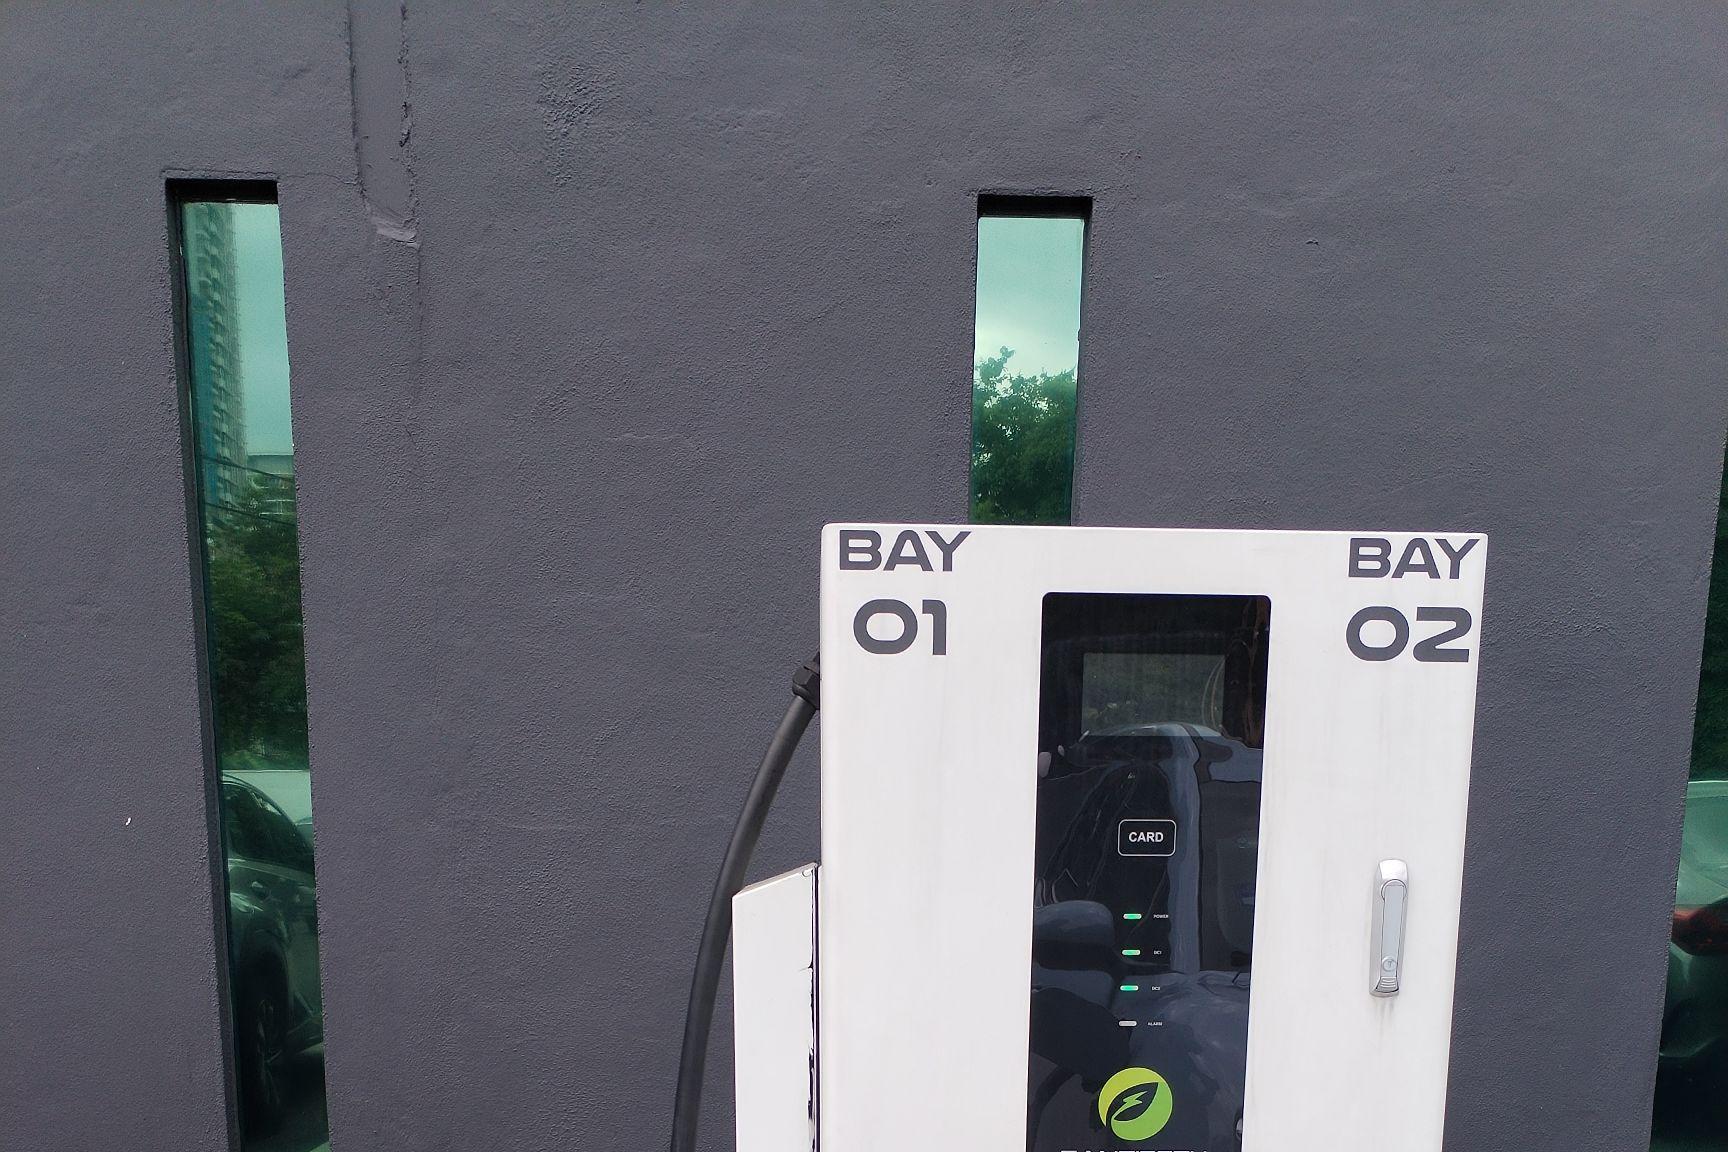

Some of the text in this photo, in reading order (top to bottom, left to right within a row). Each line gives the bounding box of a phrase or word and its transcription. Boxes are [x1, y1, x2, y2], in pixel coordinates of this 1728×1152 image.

[839, 529, 972, 572] BAY
[1347, 537, 1480, 580] BAY
[852, 598, 948, 656] 01
[1345, 605, 1473, 663] 02
[1128, 831, 1164, 843] CARD
